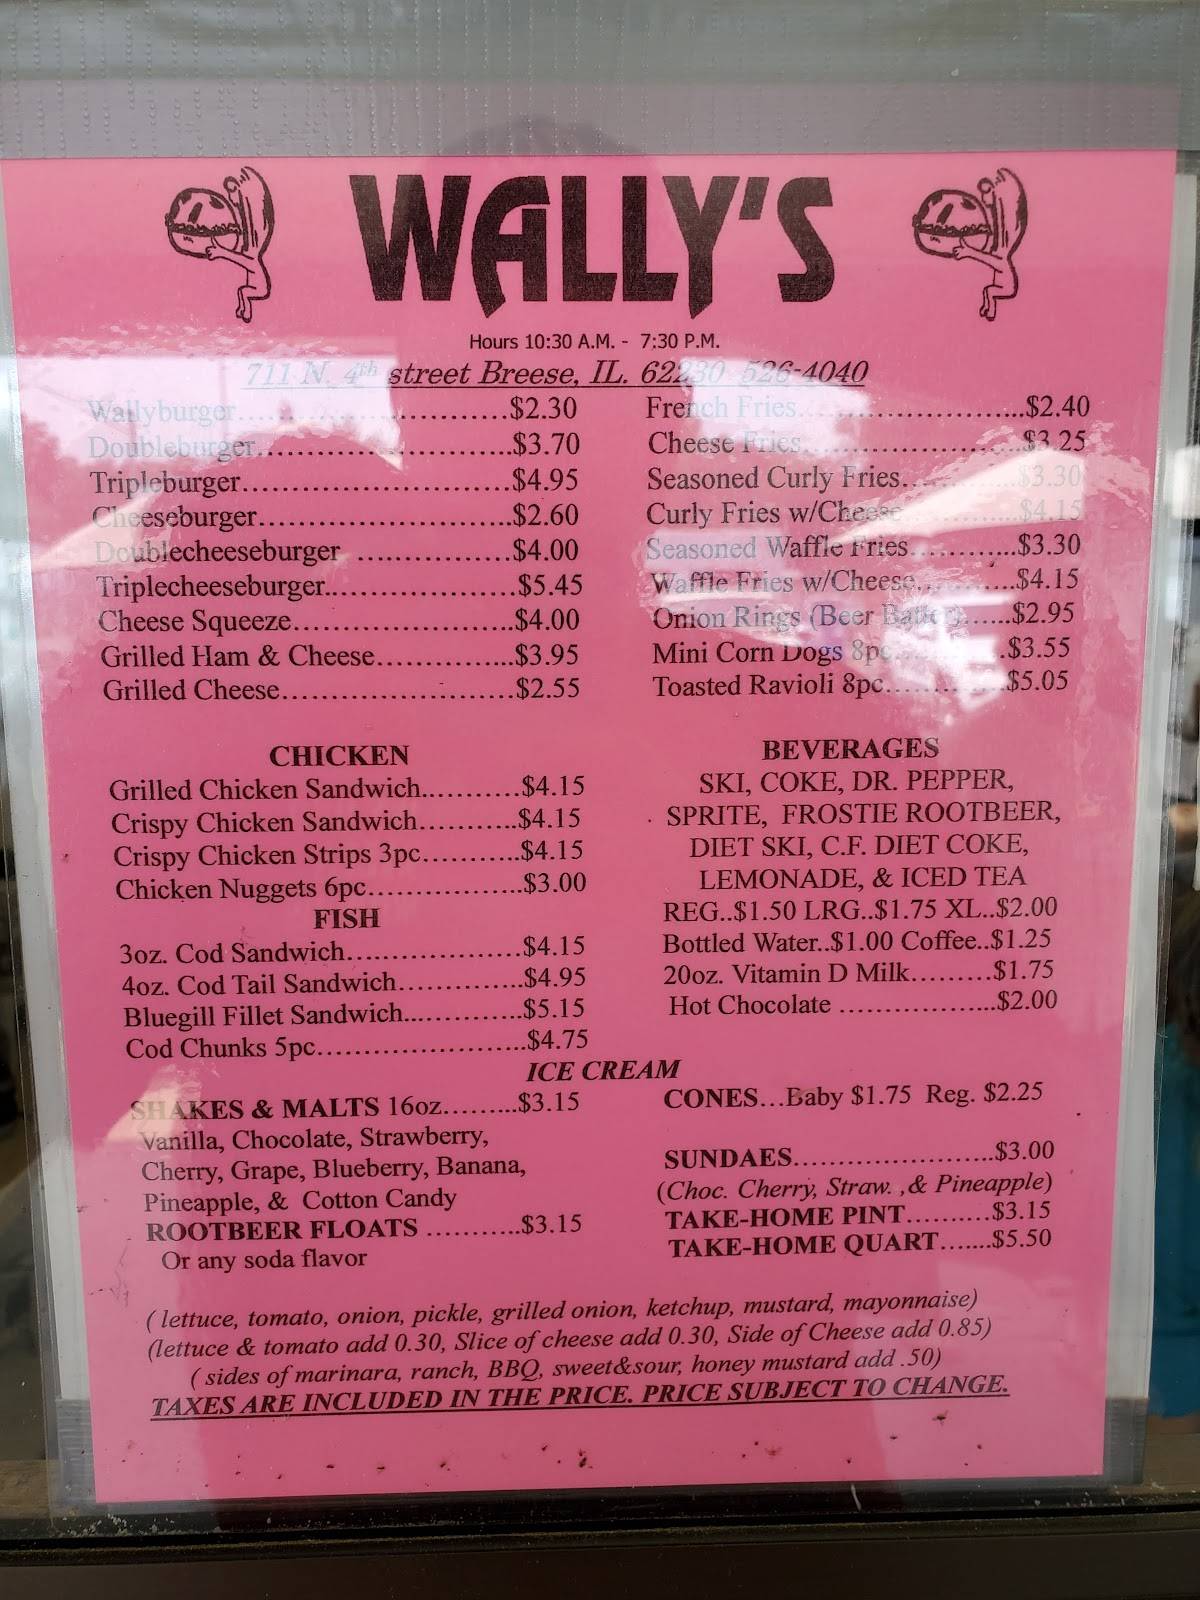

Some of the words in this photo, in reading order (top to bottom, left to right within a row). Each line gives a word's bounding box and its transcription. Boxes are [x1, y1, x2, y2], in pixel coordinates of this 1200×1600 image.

[350, 174, 835, 319] WALLY'S
[470, 334, 519, 349] Hours
[525, 333, 572, 349] 10:30
[578, 333, 615, 349] A.M.
[640, 333, 678, 351] 7:30
[685, 333, 719, 348] P.M.
[388, 361, 472, 384] street
[477, 360, 580, 388] Breese,
[589, 360, 628, 384] IL.
[510, 395, 577, 421] $2.30
[1026, 395, 1090, 419] $2.40
[513, 431, 580, 457] $3.70
[649, 430, 737, 455] Cheese
[90, 470, 241, 500] Tripleburger
[513, 467, 577, 493] $4.95
[648, 465, 760, 490] Seasoned
[767, 465, 834, 494] Curly
[841, 465, 900, 488] Fries
[513, 502, 578, 528] $2.60
[647, 502, 713, 529] Curly
[721, 500, 780, 523] Fries
[513, 538, 578, 563] $4.00
[1018, 532, 1081, 557] $3.30
[96, 573, 325, 603] Triplecheeseburger
[518, 573, 582, 598] $5.45
[1016, 568, 1079, 591] $4.15
[98, 609, 184, 632] Cheese
[192, 608, 291, 637] Squeeze
[515, 607, 579, 632] $4.00
[1012, 601, 1075, 626] $2.95
[101, 645, 185, 668] Grilled
[191, 645, 250, 667] Ham
[258, 645, 280, 666] &
[289, 644, 375, 666] Cheese
[515, 642, 578, 668] $3.95
[652, 641, 708, 664] Mini
[716, 641, 775, 663] Corn
[1008, 636, 1070, 660] $3.55
[103, 679, 188, 701] Grilled
[194, 678, 279, 700] Cheese
[516, 677, 579, 700] $2.55
[652, 674, 742, 696] Toasted
[748, 672, 834, 695] Ravioli
[843, 673, 888, 699] 8pc
[1007, 669, 1068, 692] $5.05
[270, 745, 409, 767] CHICKEN
[762, 737, 939, 760] BEVERAGES
[110, 779, 192, 801] Grilled
[200, 778, 298, 800] Chicken
[306, 777, 421, 800] Sandwich
[522, 775, 584, 798] $4.15
[700, 773, 751, 797] SKI,
[761, 771, 844, 795] COKE,
[851, 771, 897, 791] DR.
[906, 769, 1013, 793] PEPPER,
[112, 813, 188, 839] Crispy
[197, 812, 295, 833] Chicken
[303, 810, 418, 832] Sandwich
[518, 808, 580, 830] $4.15
[667, 804, 767, 829] SPRITE,
[782, 803, 898, 824] FROSTIE
[905, 801, 1061, 824] ROOTBEER,
[114, 846, 191, 872] Crispy
[198, 844, 296, 866] Chicken
[304, 843, 371, 869] Strips
[379, 843, 420, 868] 3pc
[521, 839, 582, 862] $4.15
[116, 879, 213, 902] Chicken
[218, 878, 317, 903] Nuggets
[325, 876, 366, 902] 6pc
[524, 872, 586, 894] $3.00
[700, 868, 864, 892] LEMONADE,
[872, 868, 893, 888] &
[901, 867, 967, 887] ICED
[974, 865, 1027, 886] TEA
[313, 908, 381, 929] FISH
[120, 944, 167, 964] 3oz.
[176, 943, 224, 964] Cod
[232, 941, 345, 963] Sandwich
[524, 936, 584, 958] $4.15
[122, 976, 169, 996] 4oz.
[178, 975, 226, 995] Cod
[232, 974, 276, 994] Tail
[284, 971, 397, 993] Sandwich
[524, 967, 585, 989] $4.95
[664, 965, 723, 984] 20oz.
[731, 963, 821, 984] Vitamin
[828, 963, 848, 982] D
[856, 962, 910, 982] Milk
[993, 960, 1053, 981] $1.75
[123, 1006, 216, 1032] Bluegill
[222, 1005, 284, 1026] Fillet
[291, 1002, 403, 1024] Sandwich
[523, 997, 584, 1020] $5.15
[669, 996, 711, 1015] Hot
[718, 994, 831, 1015] Chocolate
[997, 989, 1057, 1012] $2.00
[126, 1038, 174, 1059] Cod
[180, 1037, 267, 1058] Chunks
[275, 1037, 315, 1061] 5pc
[528, 1029, 588, 1051] $4.75
[526, 1062, 575, 1082] ICE
[582, 1059, 682, 1080] CREAM
[252, 1099, 274, 1119] &
[281, 1097, 379, 1118] MALTS
[389, 1096, 442, 1115] 16oz
[519, 1091, 579, 1114] $3.15
[233, 1128, 352, 1151] Chocolate,
[360, 1125, 488, 1149] Strawberry,
[665, 1148, 792, 1169] SUNDAES
[995, 1140, 1054, 1162] $3.00
[142, 1161, 223, 1185] Cherry,
[231, 1161, 305, 1184] Grape,
[312, 1157, 429, 1181] Blueberry,
[436, 1156, 526, 1177] Banana,
[144, 1192, 260, 1216] Pineapple,
[268, 1191, 288, 1210] &
[303, 1191, 379, 1209] Cotton
[386, 1187, 456, 1211] Candy
[665, 1207, 833, 1229] TAKE-HOME
[842, 1205, 905, 1224] PINT
[992, 1201, 1050, 1222] $3.15
[146, 1221, 303, 1241] ROOTBEER
[309, 1218, 417, 1239] FLOATS
[522, 1214, 581, 1235] $3.15
[668, 1235, 836, 1258] TAKE-HOME
[844, 1232, 939, 1256] QUART
[992, 1229, 1051, 1249] $5.50
[162, 1251, 191, 1270] Or
[198, 1256, 236, 1273] any
[245, 1249, 295, 1269] soda
[301, 1248, 367, 1267] flavor
[248, 1310, 328, 1327] tomato,
[337, 1311, 404, 1326] onion,
[411, 1303, 482, 1328] pickle,
[491, 1300, 566, 1326] grilled
[571, 1300, 636, 1319] onion,
[646, 1297, 733, 1320] ketchup,
[744, 1293, 834, 1314] mustard,
[843, 1288, 977, 1315] mayonnaise)
[152, 1396, 236, 1416] TAXES
[239, 1394, 296, 1414] ARE
[301, 1391, 442, 1412] INCLUDED
[449, 1389, 481, 1407] IN
[488, 1388, 541, 1406] THE
[547, 1385, 633, 1405] PRICE.
[642, 1384, 723, 1403] PRICE
[727, 1379, 847, 1400] SUBJECT
[853, 1378, 886, 1397] TO
[893, 1375, 1007, 1395] CHANGE.
